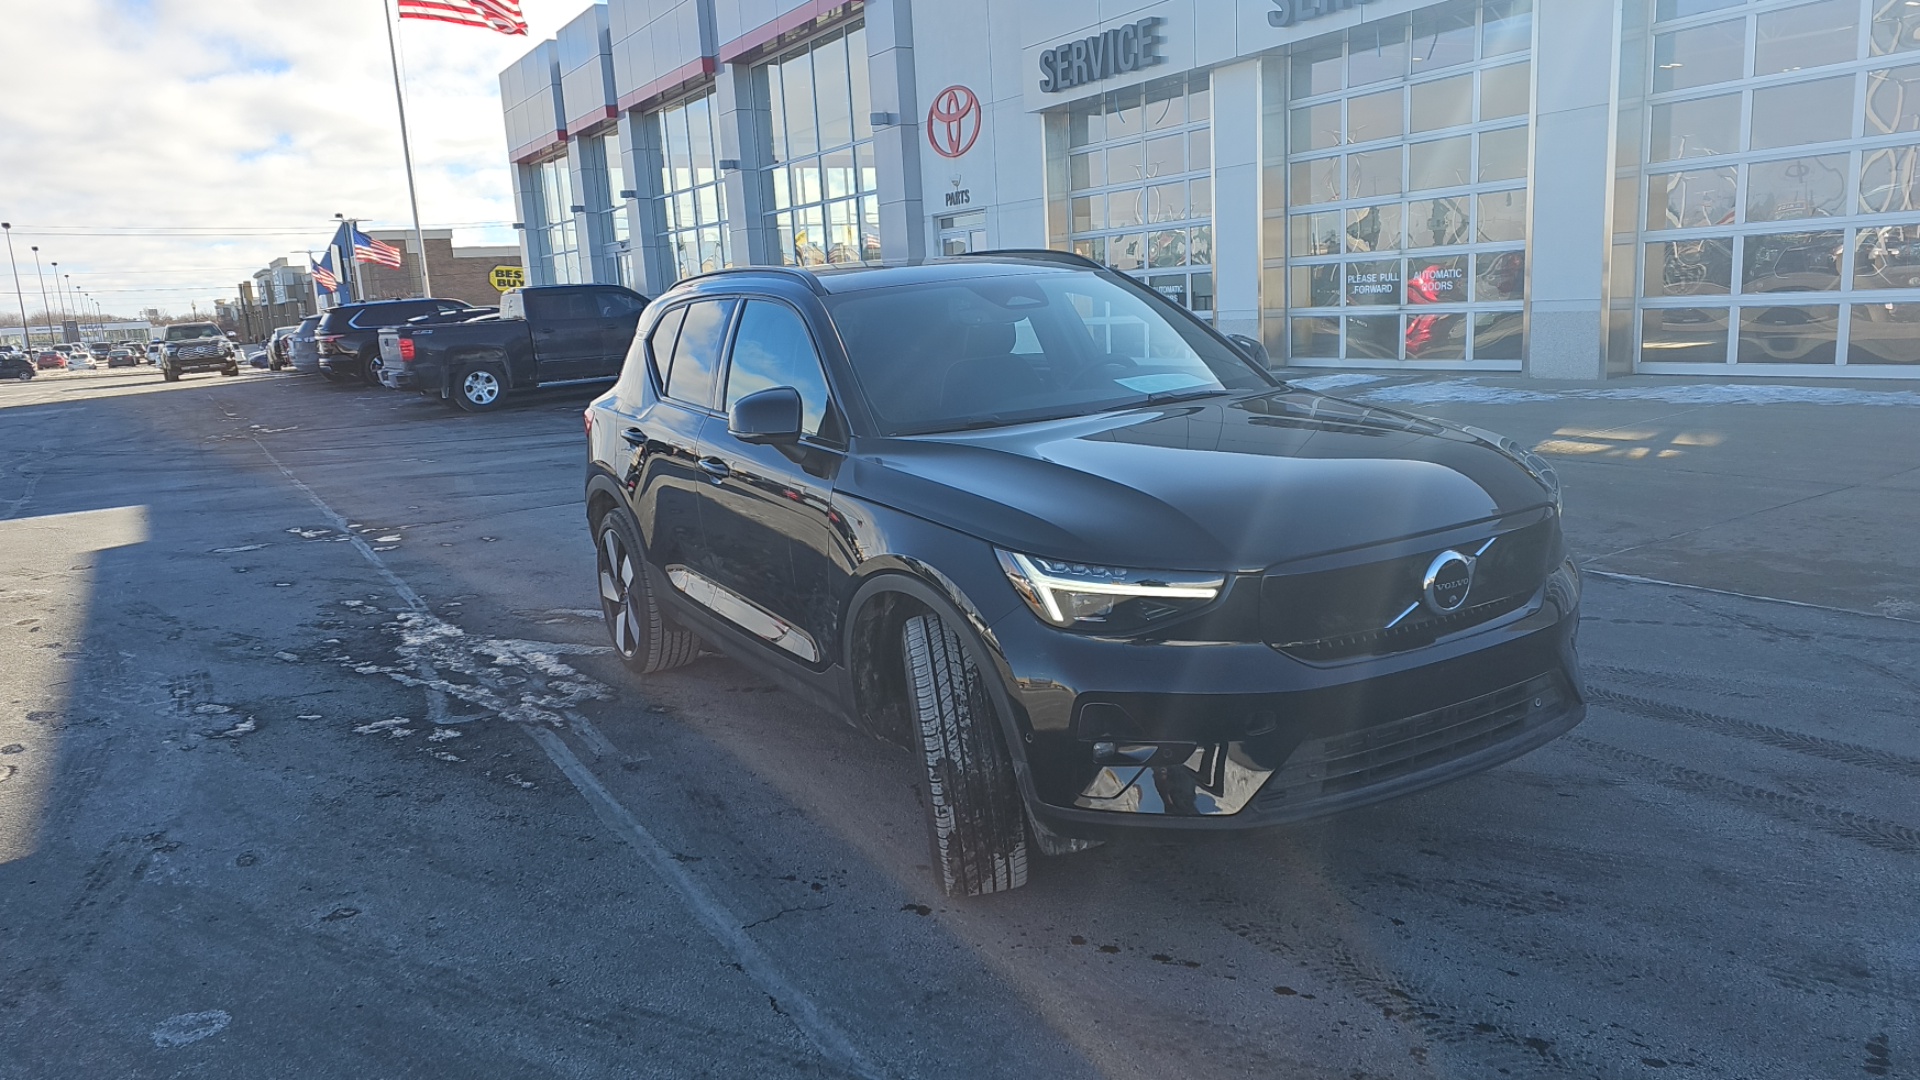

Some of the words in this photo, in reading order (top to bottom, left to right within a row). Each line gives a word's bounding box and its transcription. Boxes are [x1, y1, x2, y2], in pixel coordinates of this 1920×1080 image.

[1039, 17, 1163, 93] SERVICE
[945, 189, 970, 207] PARTS
[495, 269, 524, 279] BES
[1347, 273, 1377, 284] PLEASE
[1380, 272, 1400, 283] PULL
[1413, 269, 1463, 280] AUTOMATIC
[496, 278, 525, 287] BUY
[1421, 281, 1454, 291] DOORS
[1354, 284, 1393, 295] FORWARD
[1435, 578, 1469, 591] VOLVO
